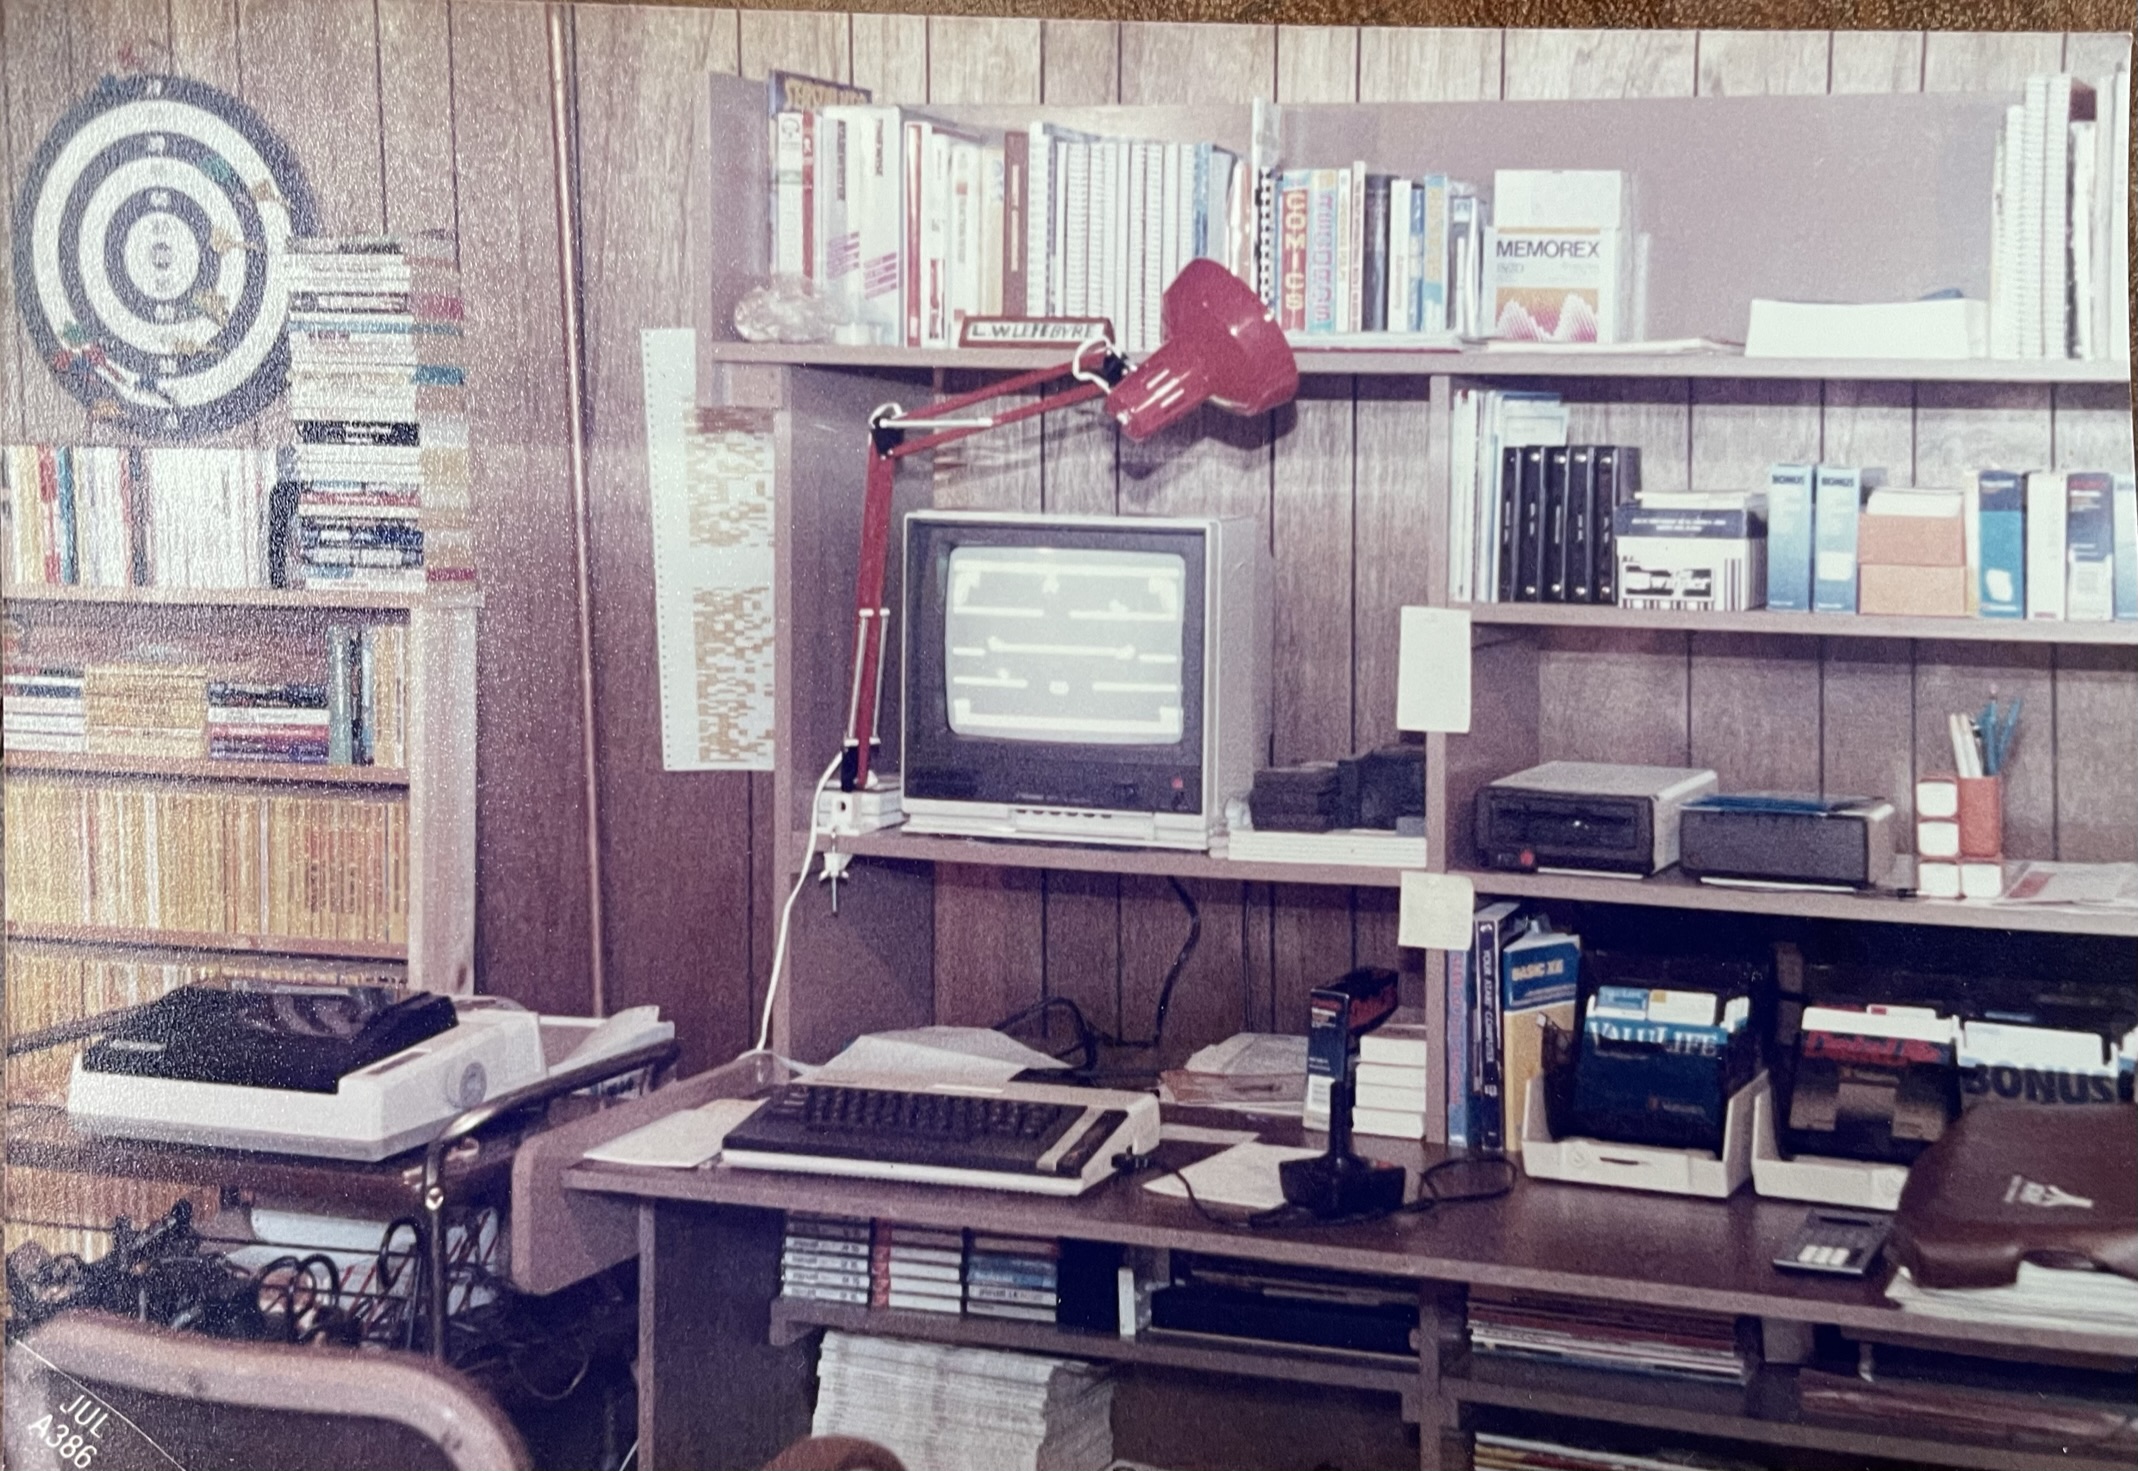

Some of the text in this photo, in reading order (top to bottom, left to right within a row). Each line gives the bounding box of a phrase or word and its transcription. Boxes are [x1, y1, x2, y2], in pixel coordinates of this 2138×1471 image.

[1285, 191, 1307, 311] COMICS
[1495, 239, 1600, 259] MEMOREX
[1511, 962, 1545, 982] BASIC
[1482, 950, 1496, 1063] YOUR ATARI COMPUTER
[1961, 1063, 2116, 1105] BONUS
